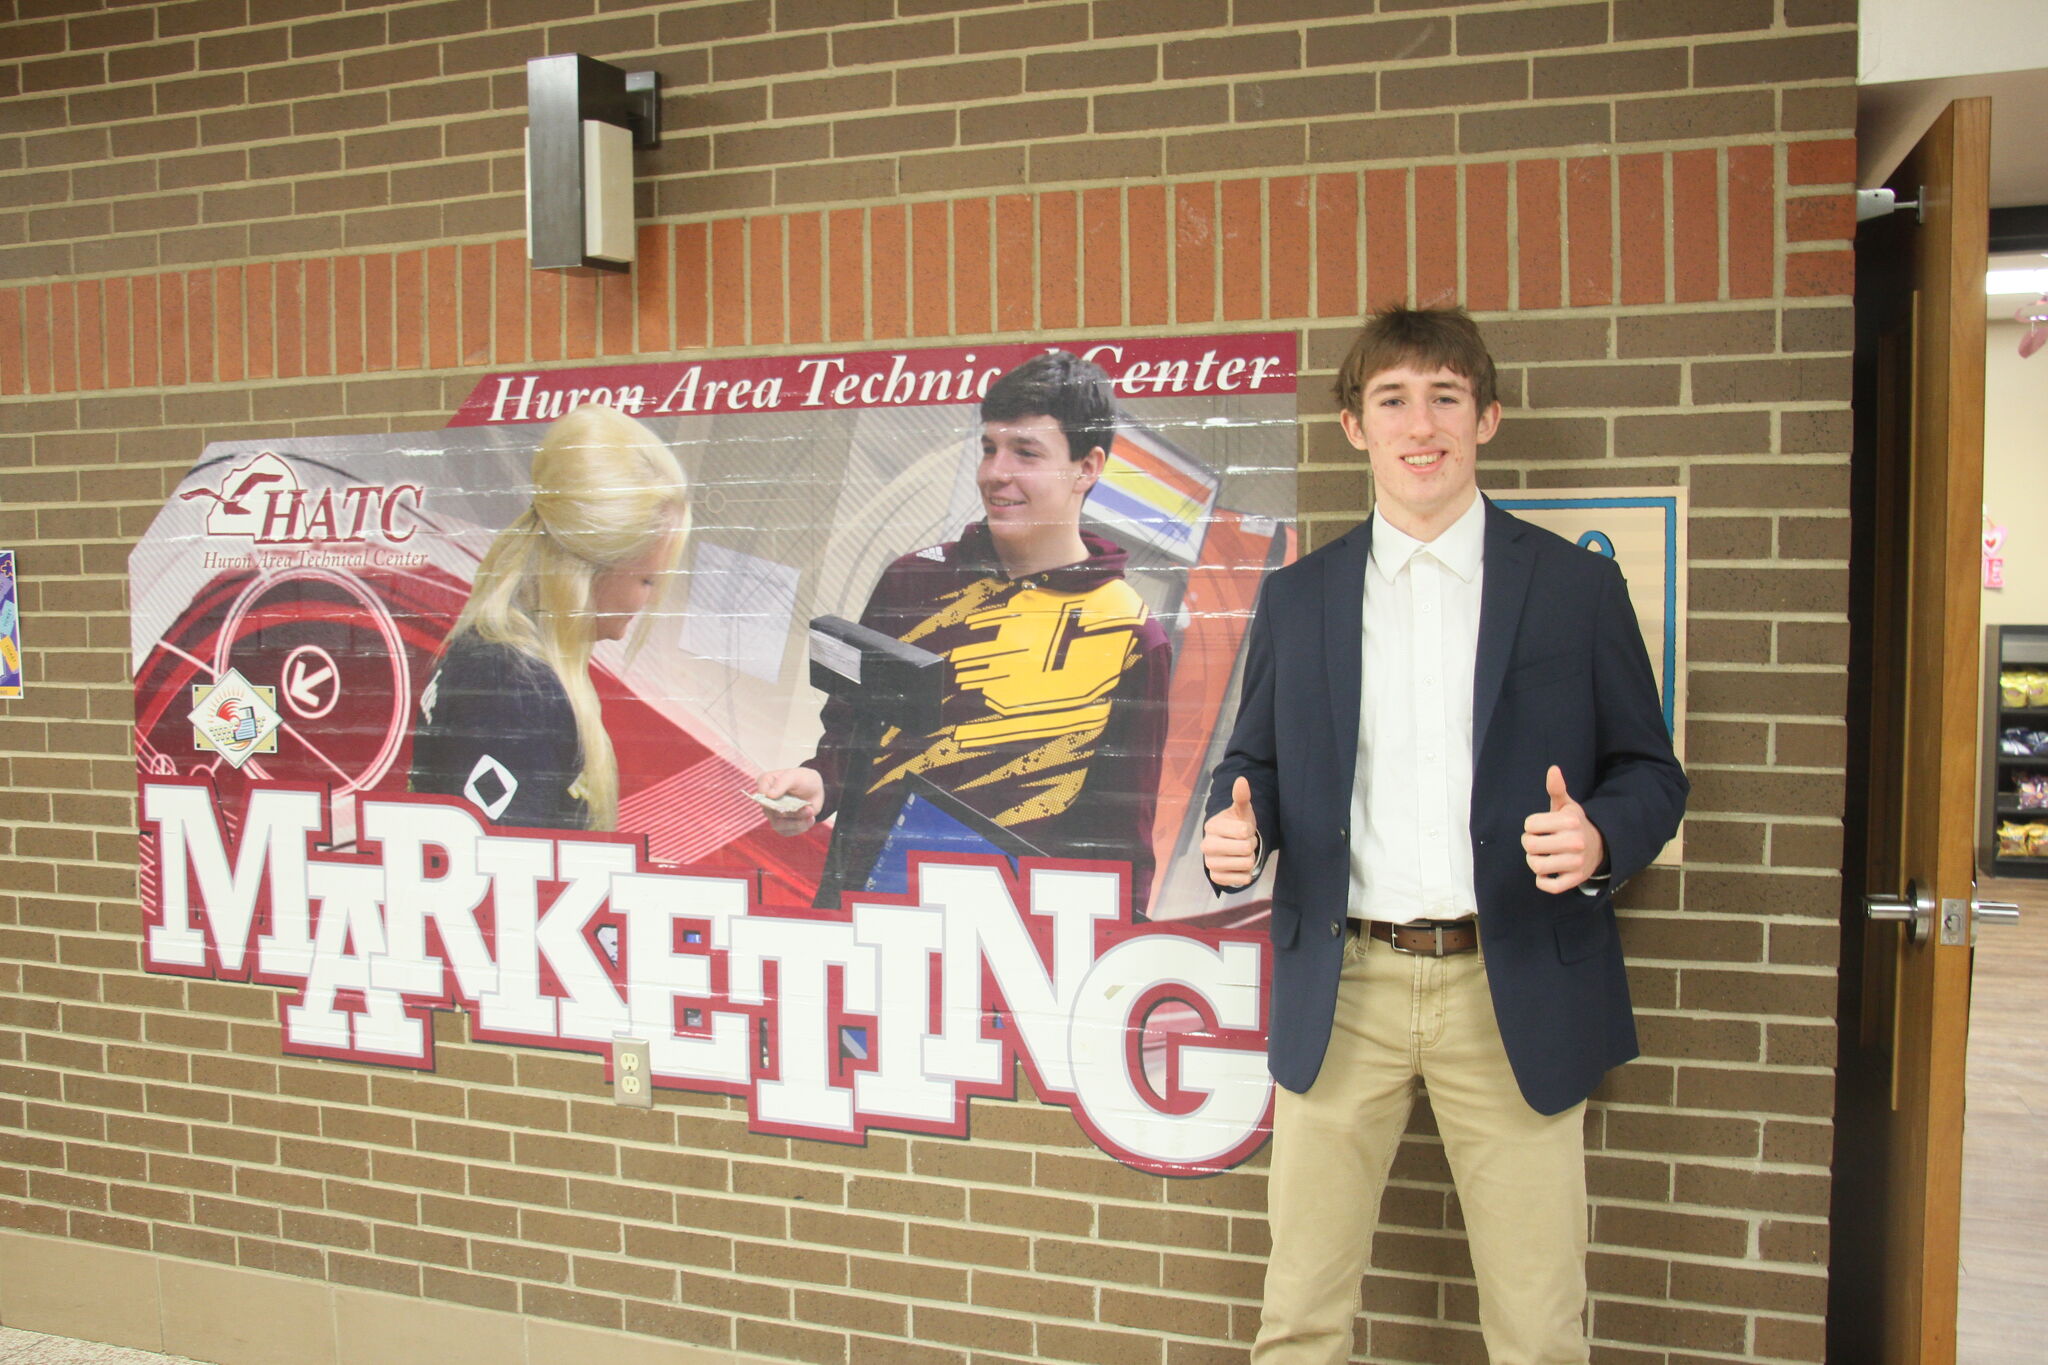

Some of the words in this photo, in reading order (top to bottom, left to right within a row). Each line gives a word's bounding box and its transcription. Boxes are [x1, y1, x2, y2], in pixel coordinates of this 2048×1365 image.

[487, 376, 645, 421] Huron
[654, 366, 783, 413] Area
[798, 347, 1059, 406] Technic
[254, 484, 424, 544] HATC
[203, 551, 251, 568] Huron
[256, 551, 294, 568] Area
[297, 549, 368, 567] Technical
[374, 549, 428, 566] Center
[143, 784, 1273, 1164] MARKETING
